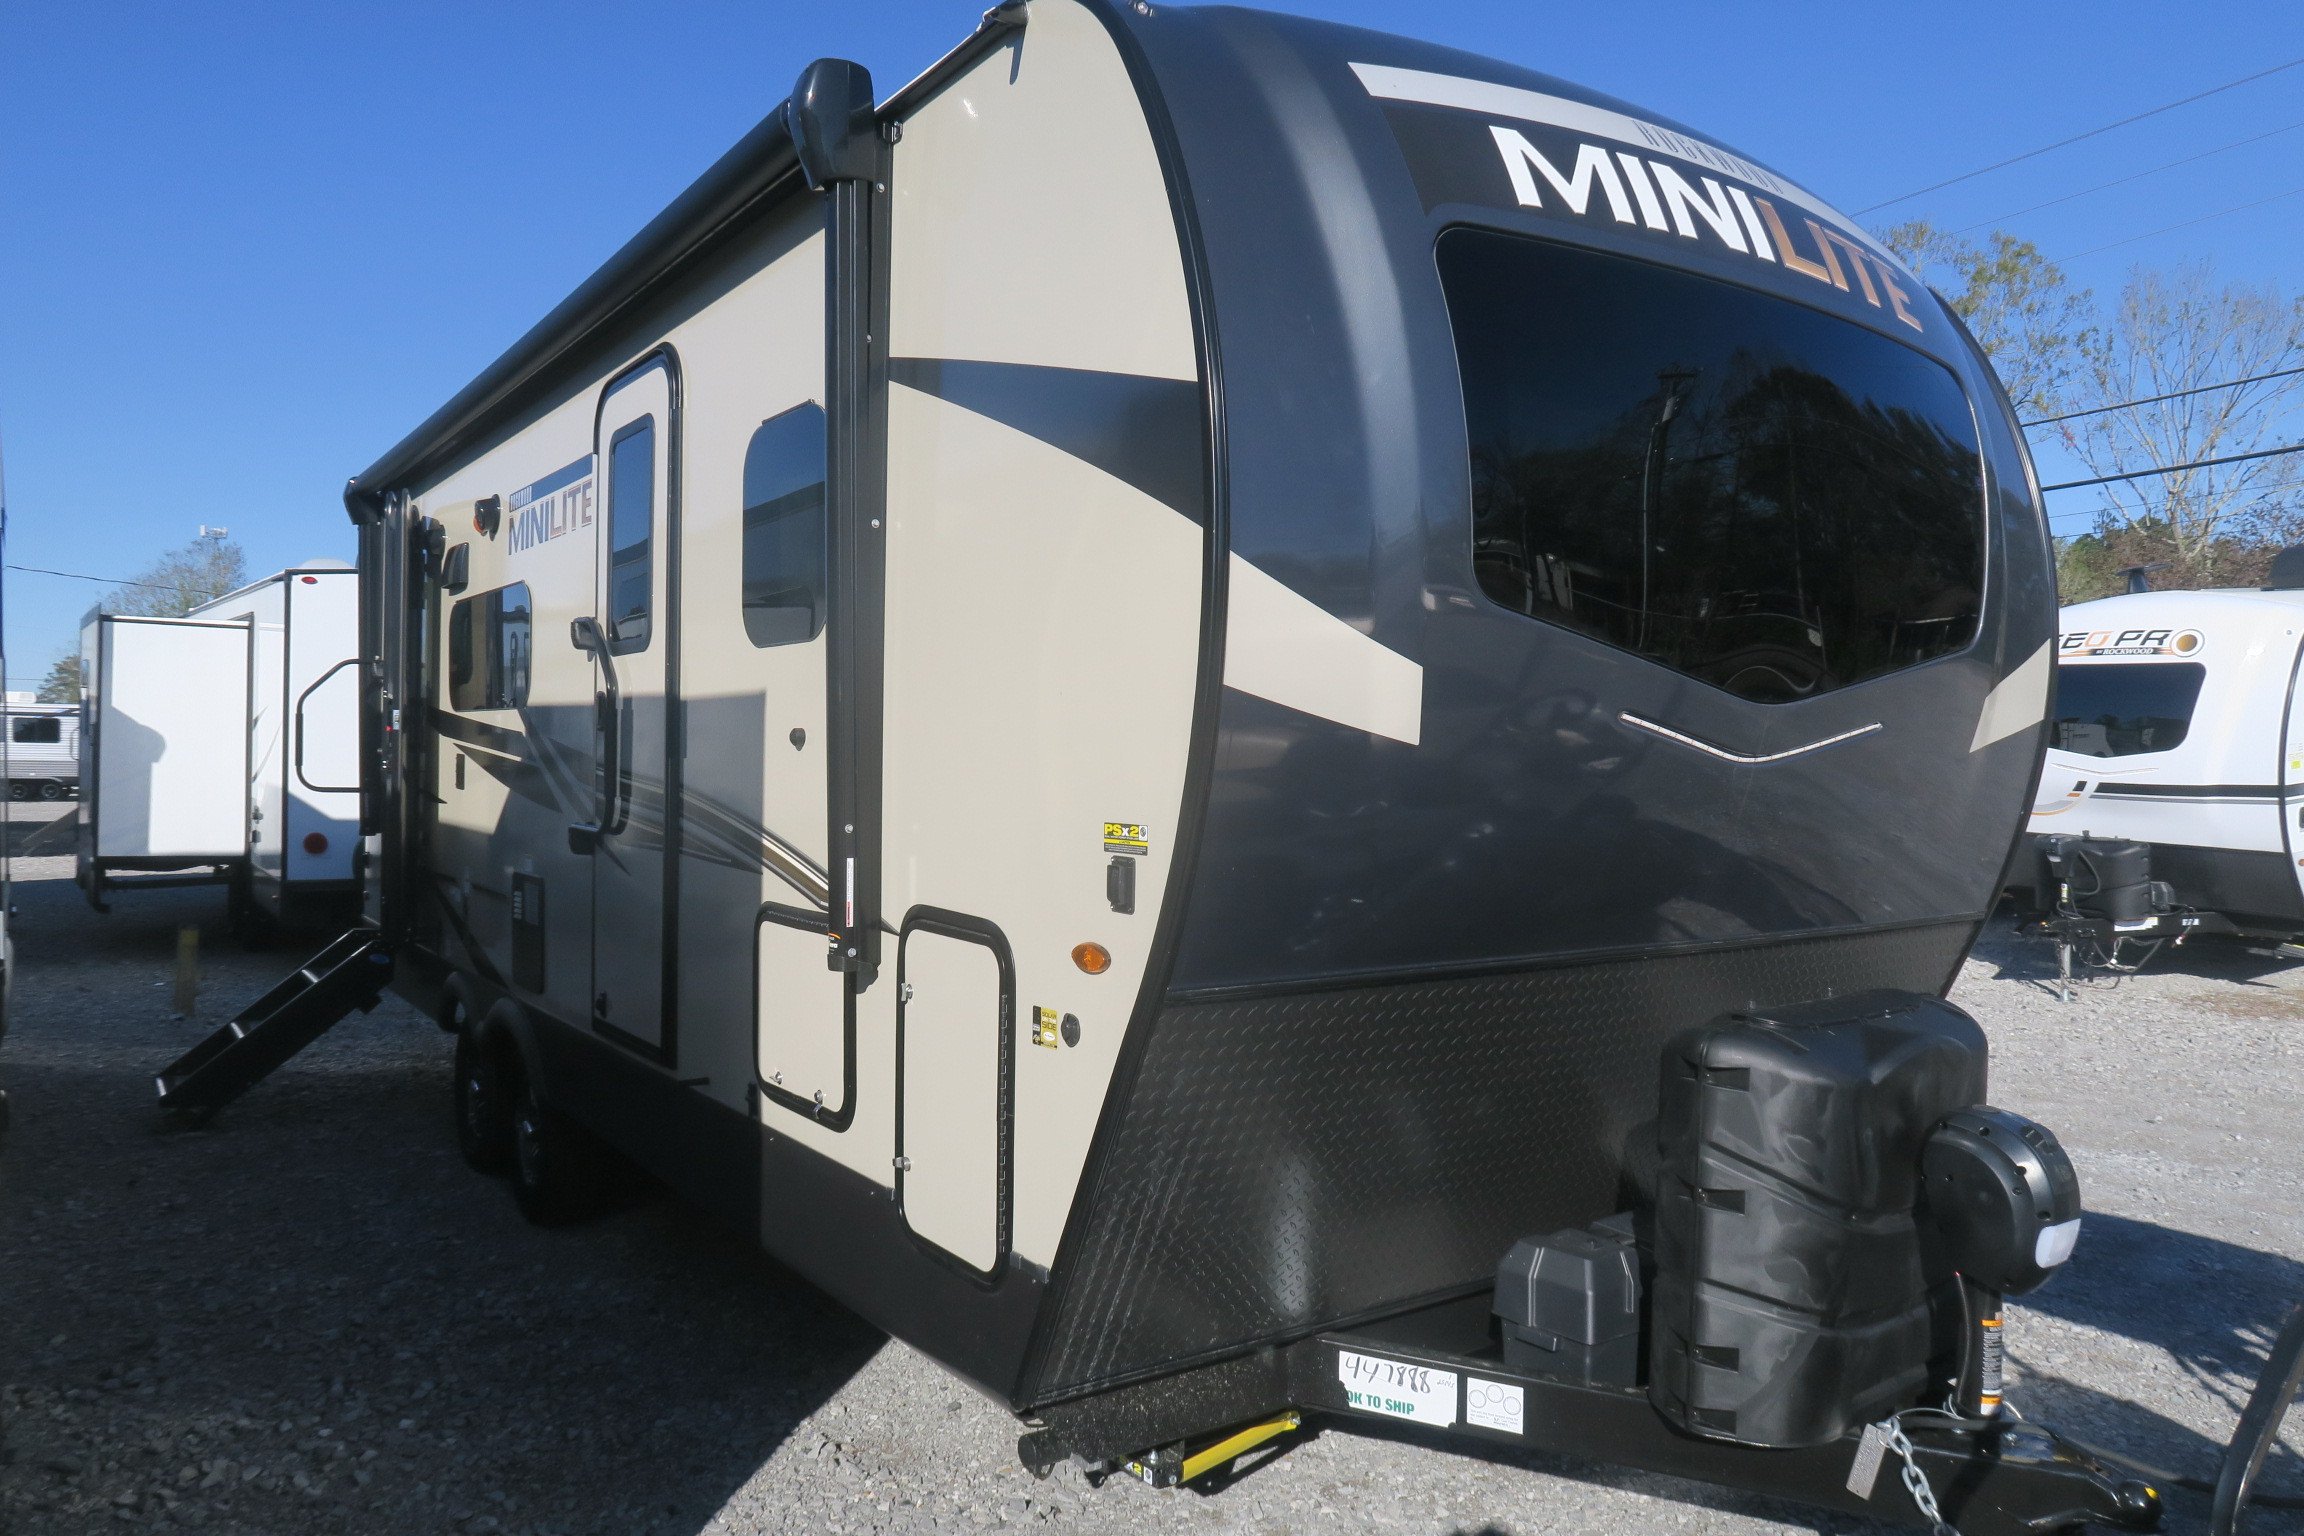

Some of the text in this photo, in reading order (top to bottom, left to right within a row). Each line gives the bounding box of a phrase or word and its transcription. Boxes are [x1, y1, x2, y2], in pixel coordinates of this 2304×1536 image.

[1488, 125, 1923, 333] MINILITE
[508, 478, 592, 556] MINILITE
[2059, 630, 2112, 649] EO
[1104, 823, 1139, 836] PSx2
[1345, 1355, 1431, 1395] 447888
[1366, 1394, 1381, 1409] TO
[1385, 1398, 1415, 1415] SHIP
